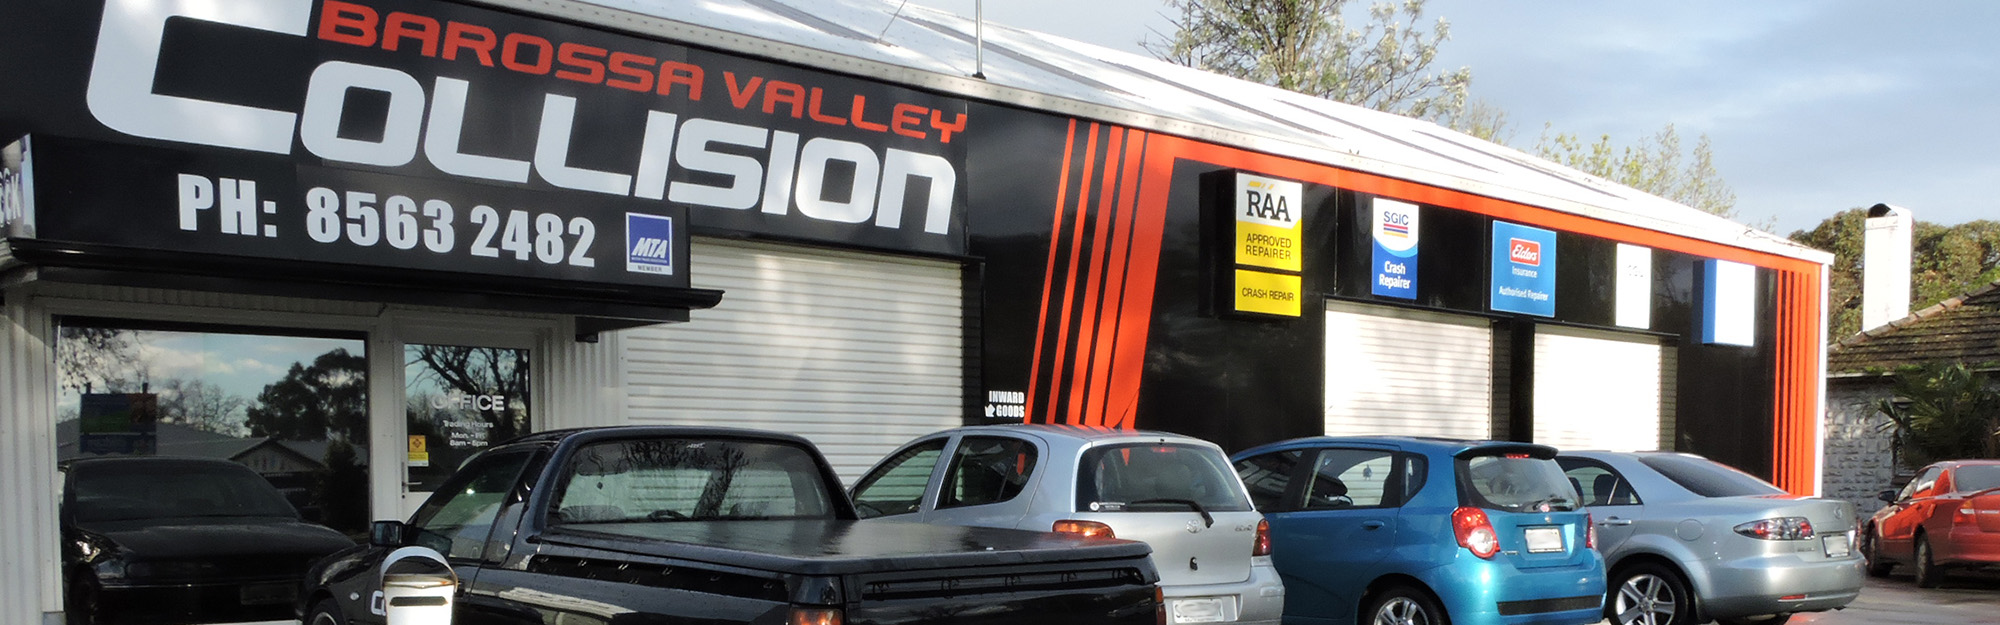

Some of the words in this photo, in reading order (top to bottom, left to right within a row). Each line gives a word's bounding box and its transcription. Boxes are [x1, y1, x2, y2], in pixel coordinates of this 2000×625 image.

[317, 0, 704, 101] BAROSSA
[723, 71, 967, 144] VALLEY
[1246, 189, 1291, 222] RAA
[178, 173, 277, 238] PH:
[306, 187, 455, 253] 8563
[470, 205, 596, 268] 2482
[1383, 211, 1409, 226] SGIC
[631, 237, 668, 259] MTA
[1246, 233, 1292, 248] APPROVED
[1245, 245, 1291, 260] REPAIRER
[1512, 244, 1538, 261] Elders
[1384, 260, 1406, 275] Crash
[1512, 265, 1538, 278] Insurance
[1379, 273, 1411, 289] Repairer
[1242, 287, 1268, 300] CRASH
[1269, 290, 1294, 301] REPAIR
[431, 394, 505, 411] OFFICE
[988, 390, 1025, 404] INWARD
[996, 404, 1025, 418] GOODS
[442, 420, 470, 430] Trading
[471, 421, 494, 429] Hours
